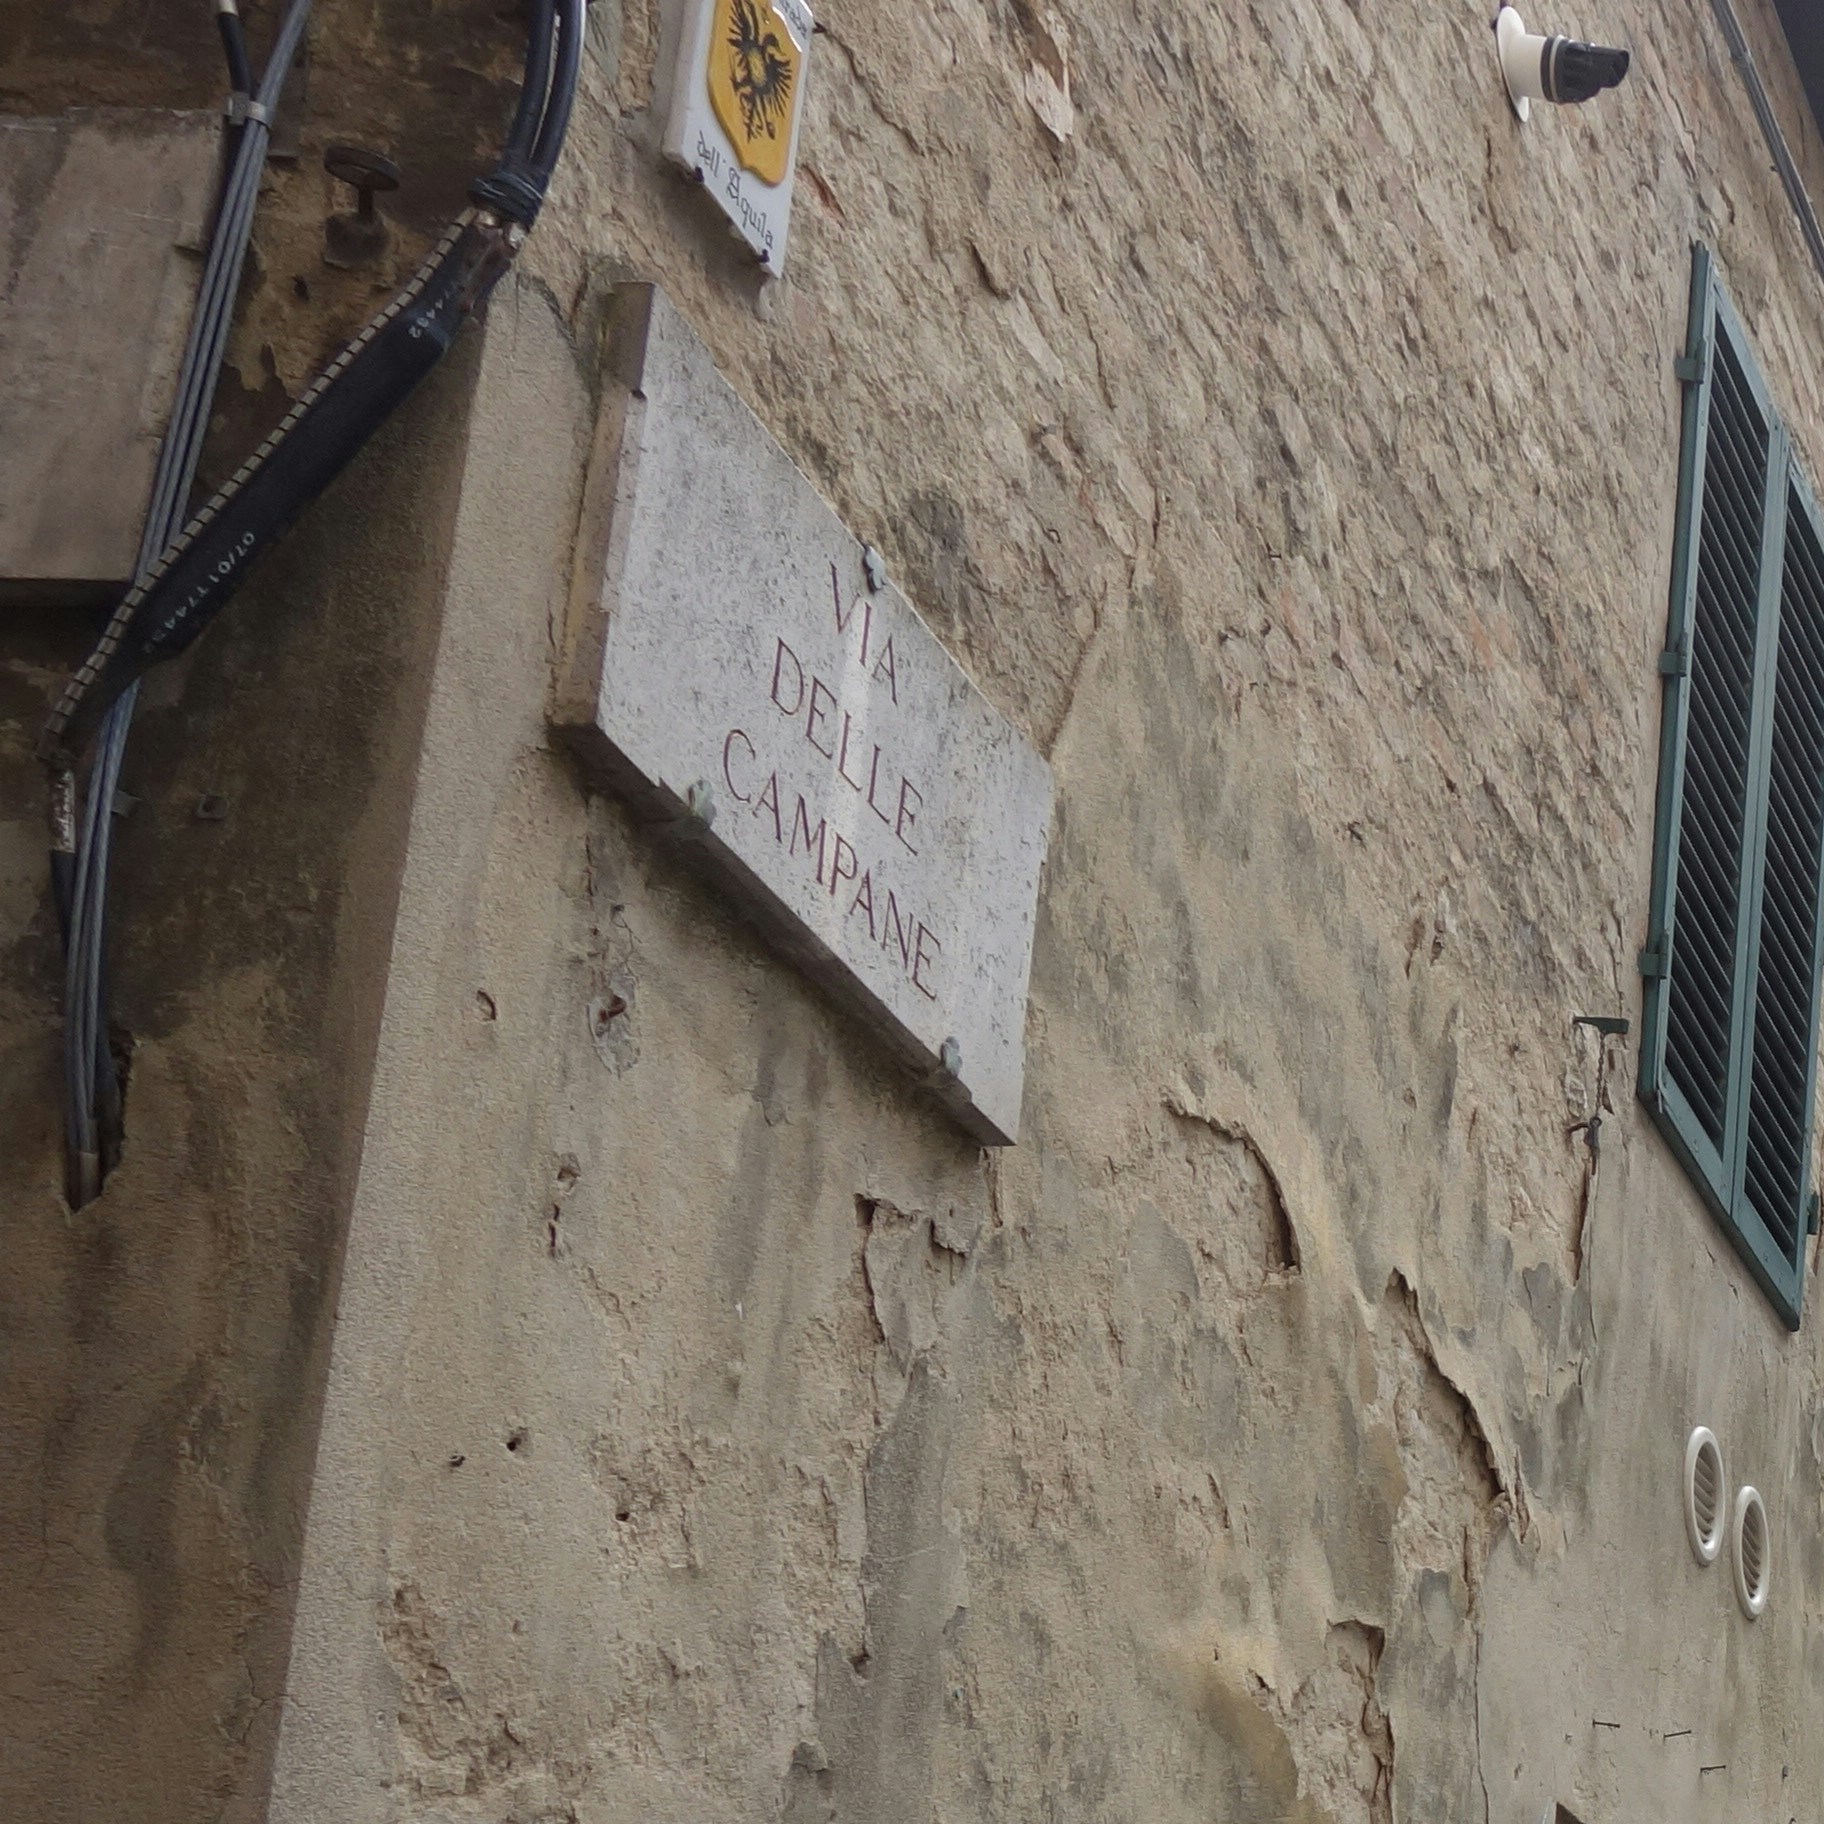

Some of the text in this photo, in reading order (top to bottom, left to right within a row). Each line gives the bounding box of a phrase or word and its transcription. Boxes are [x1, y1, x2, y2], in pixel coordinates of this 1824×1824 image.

[726, 167, 774, 250] Aquila
[829, 560, 898, 706] VIA
[770, 636, 924, 857] DELLE
[722, 728, 942, 1001] CAMPANE
